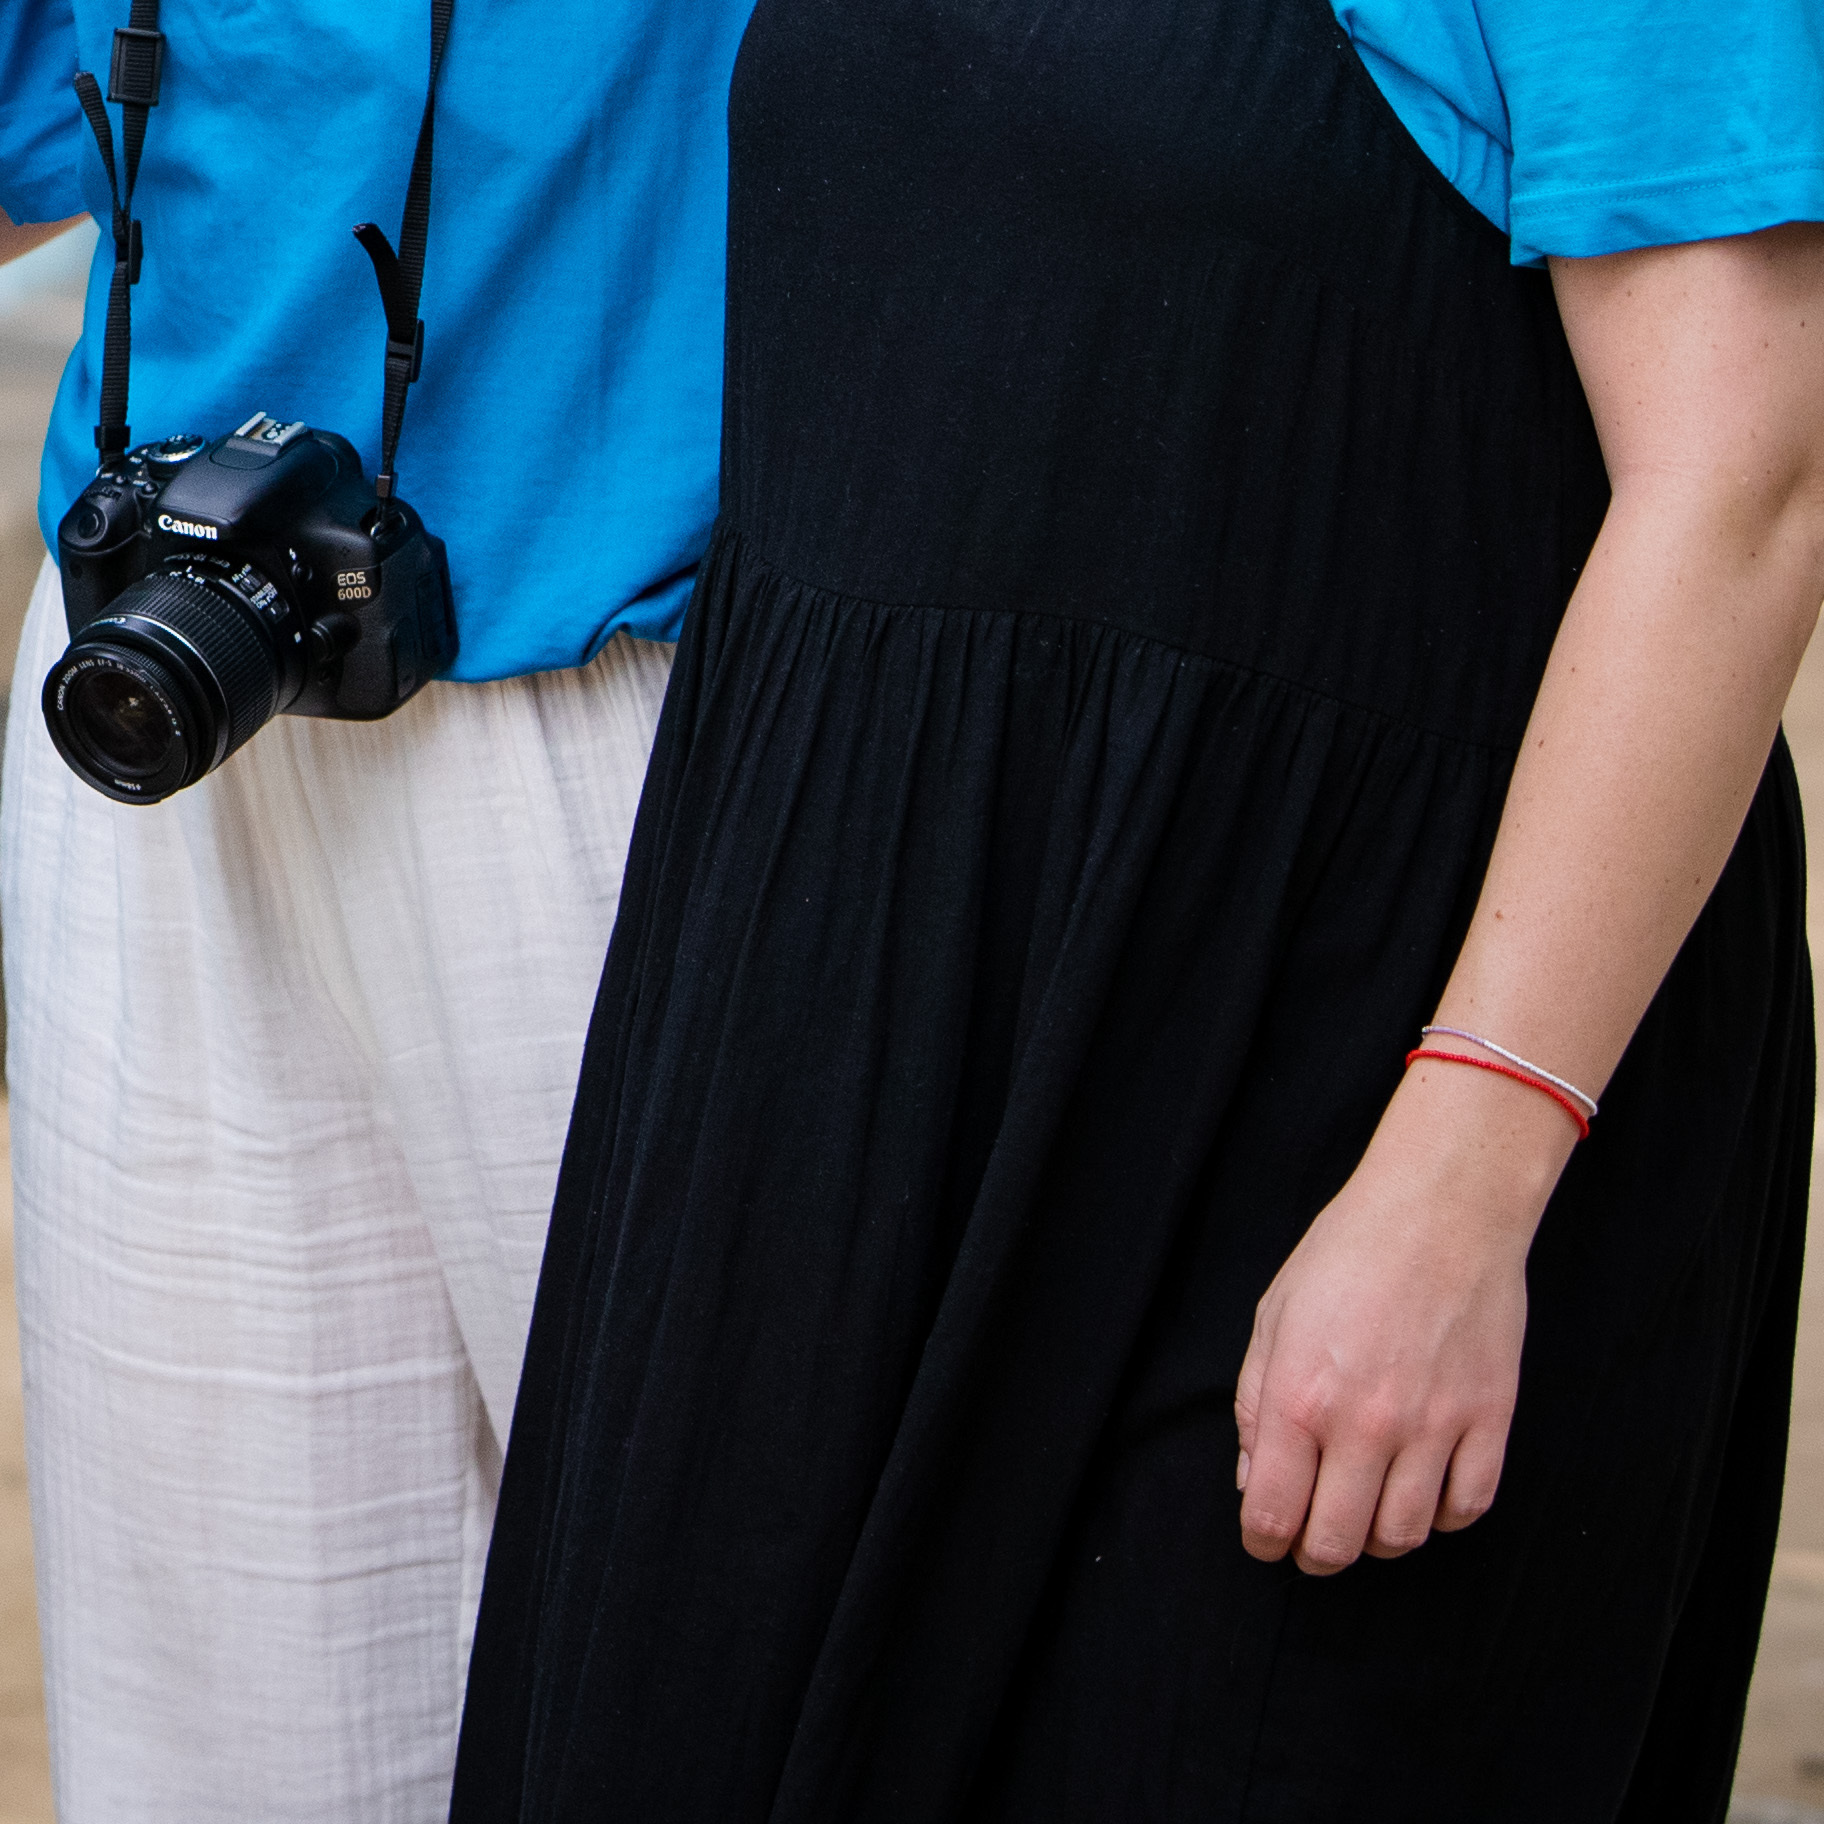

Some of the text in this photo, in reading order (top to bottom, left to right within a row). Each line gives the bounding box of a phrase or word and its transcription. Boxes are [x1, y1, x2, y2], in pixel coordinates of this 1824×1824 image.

[158, 514, 218, 540] Canon
[337, 571, 367, 587] EOS
[337, 586, 372, 601] 600D
